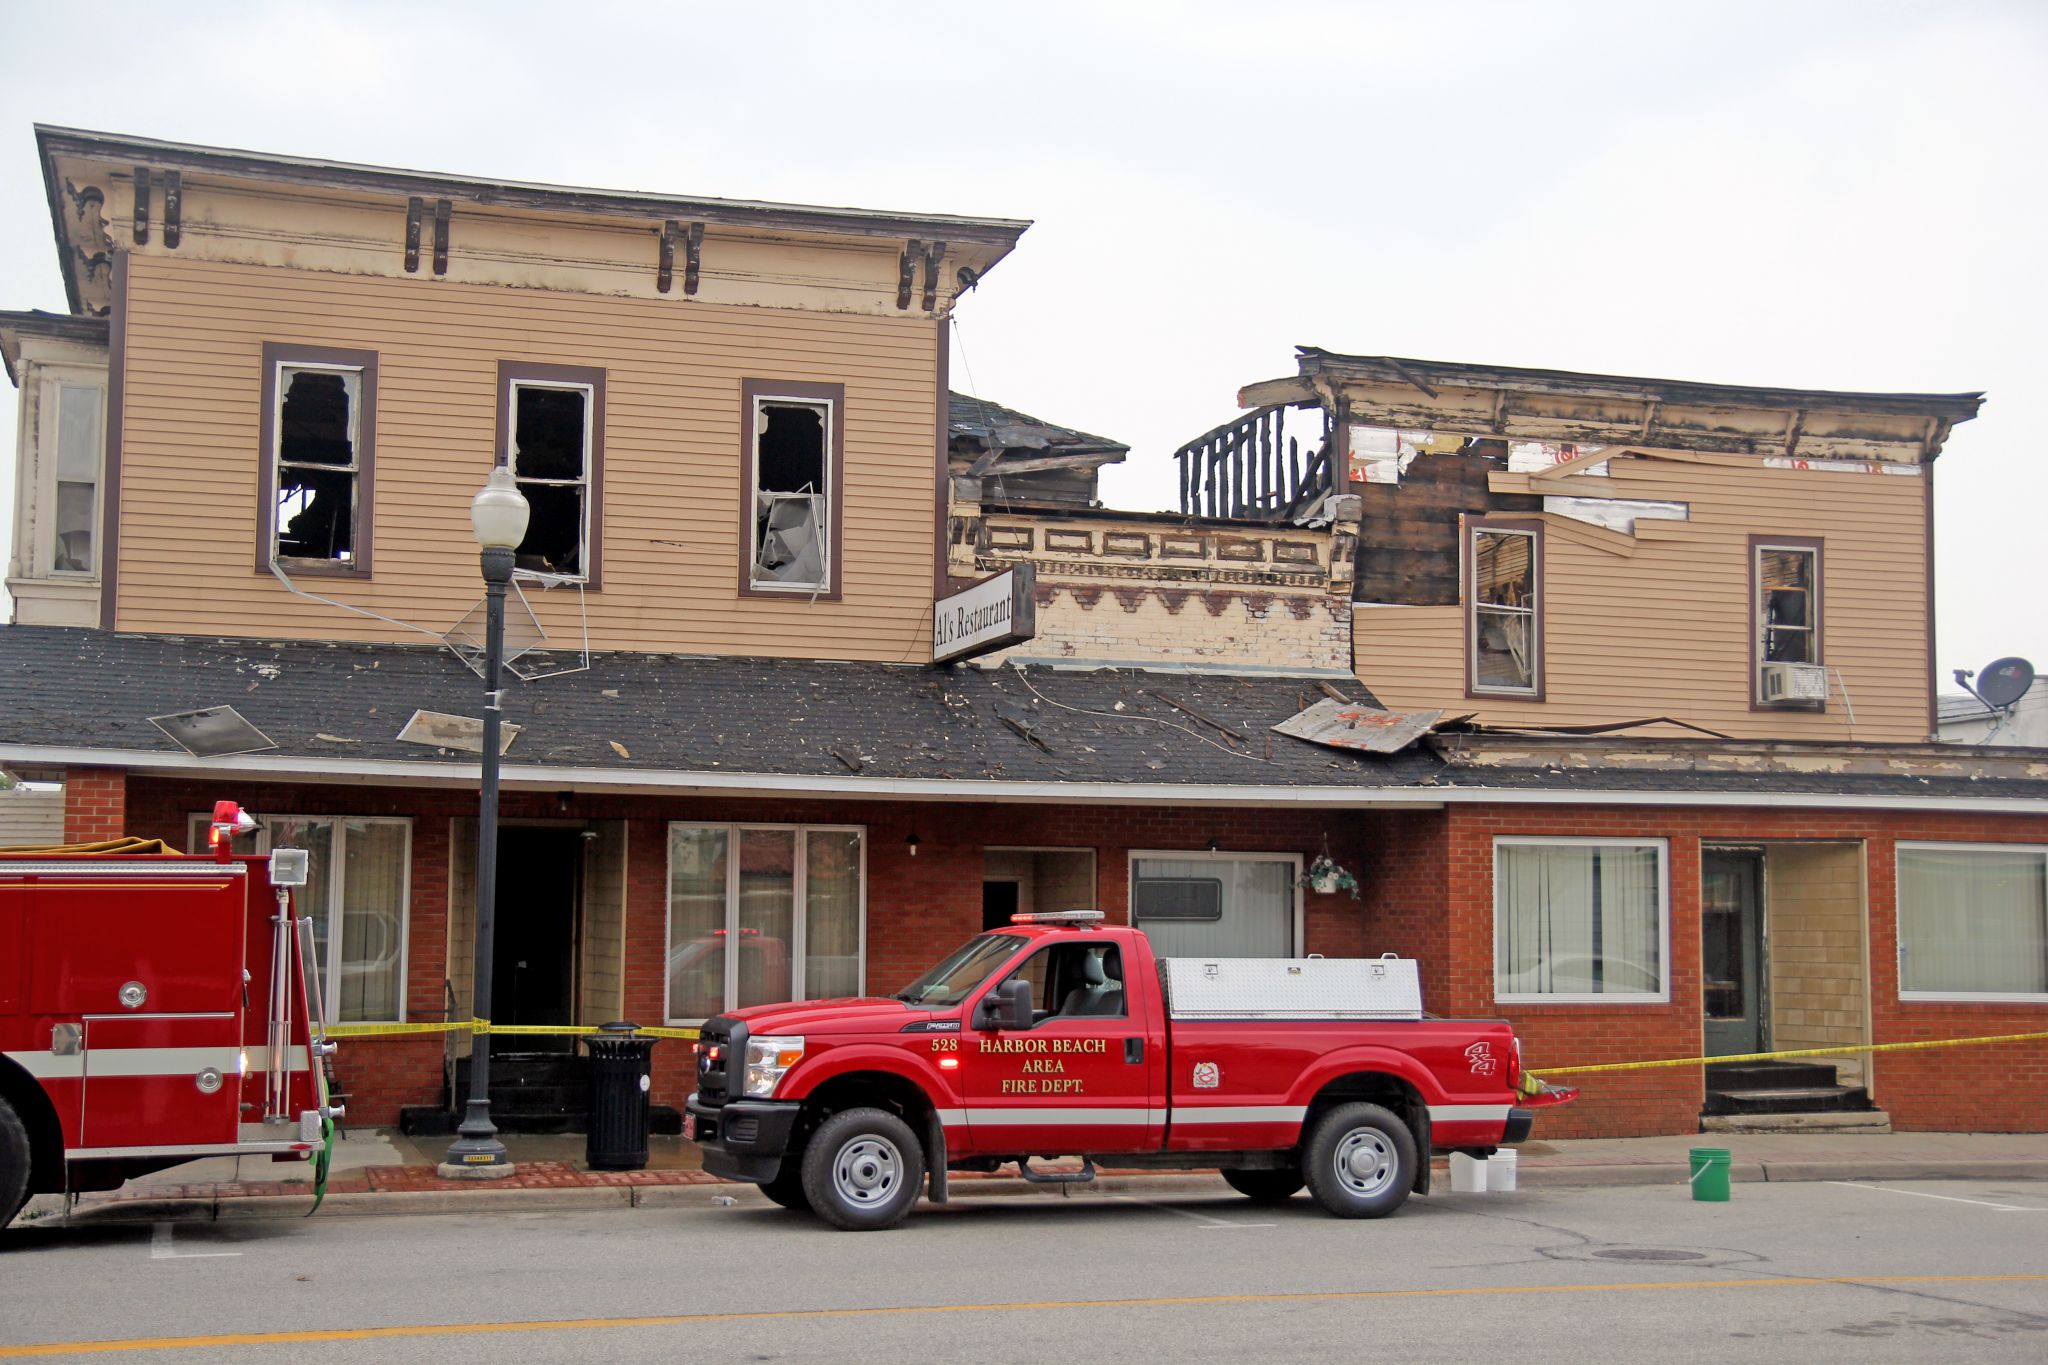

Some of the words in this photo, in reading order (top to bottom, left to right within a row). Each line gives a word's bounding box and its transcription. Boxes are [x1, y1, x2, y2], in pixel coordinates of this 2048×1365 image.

[936, 613, 954, 646] Al's
[957, 594, 1011, 638] Restaurant
[931, 1038, 958, 1052] 528
[979, 1039, 1048, 1053] HARBOR
[1053, 1039, 1106, 1053] BEACH
[1022, 1059, 1065, 1073] AREA
[1001, 1079, 1037, 1094] FIRE
[1041, 1079, 1084, 1094] DEPT.
